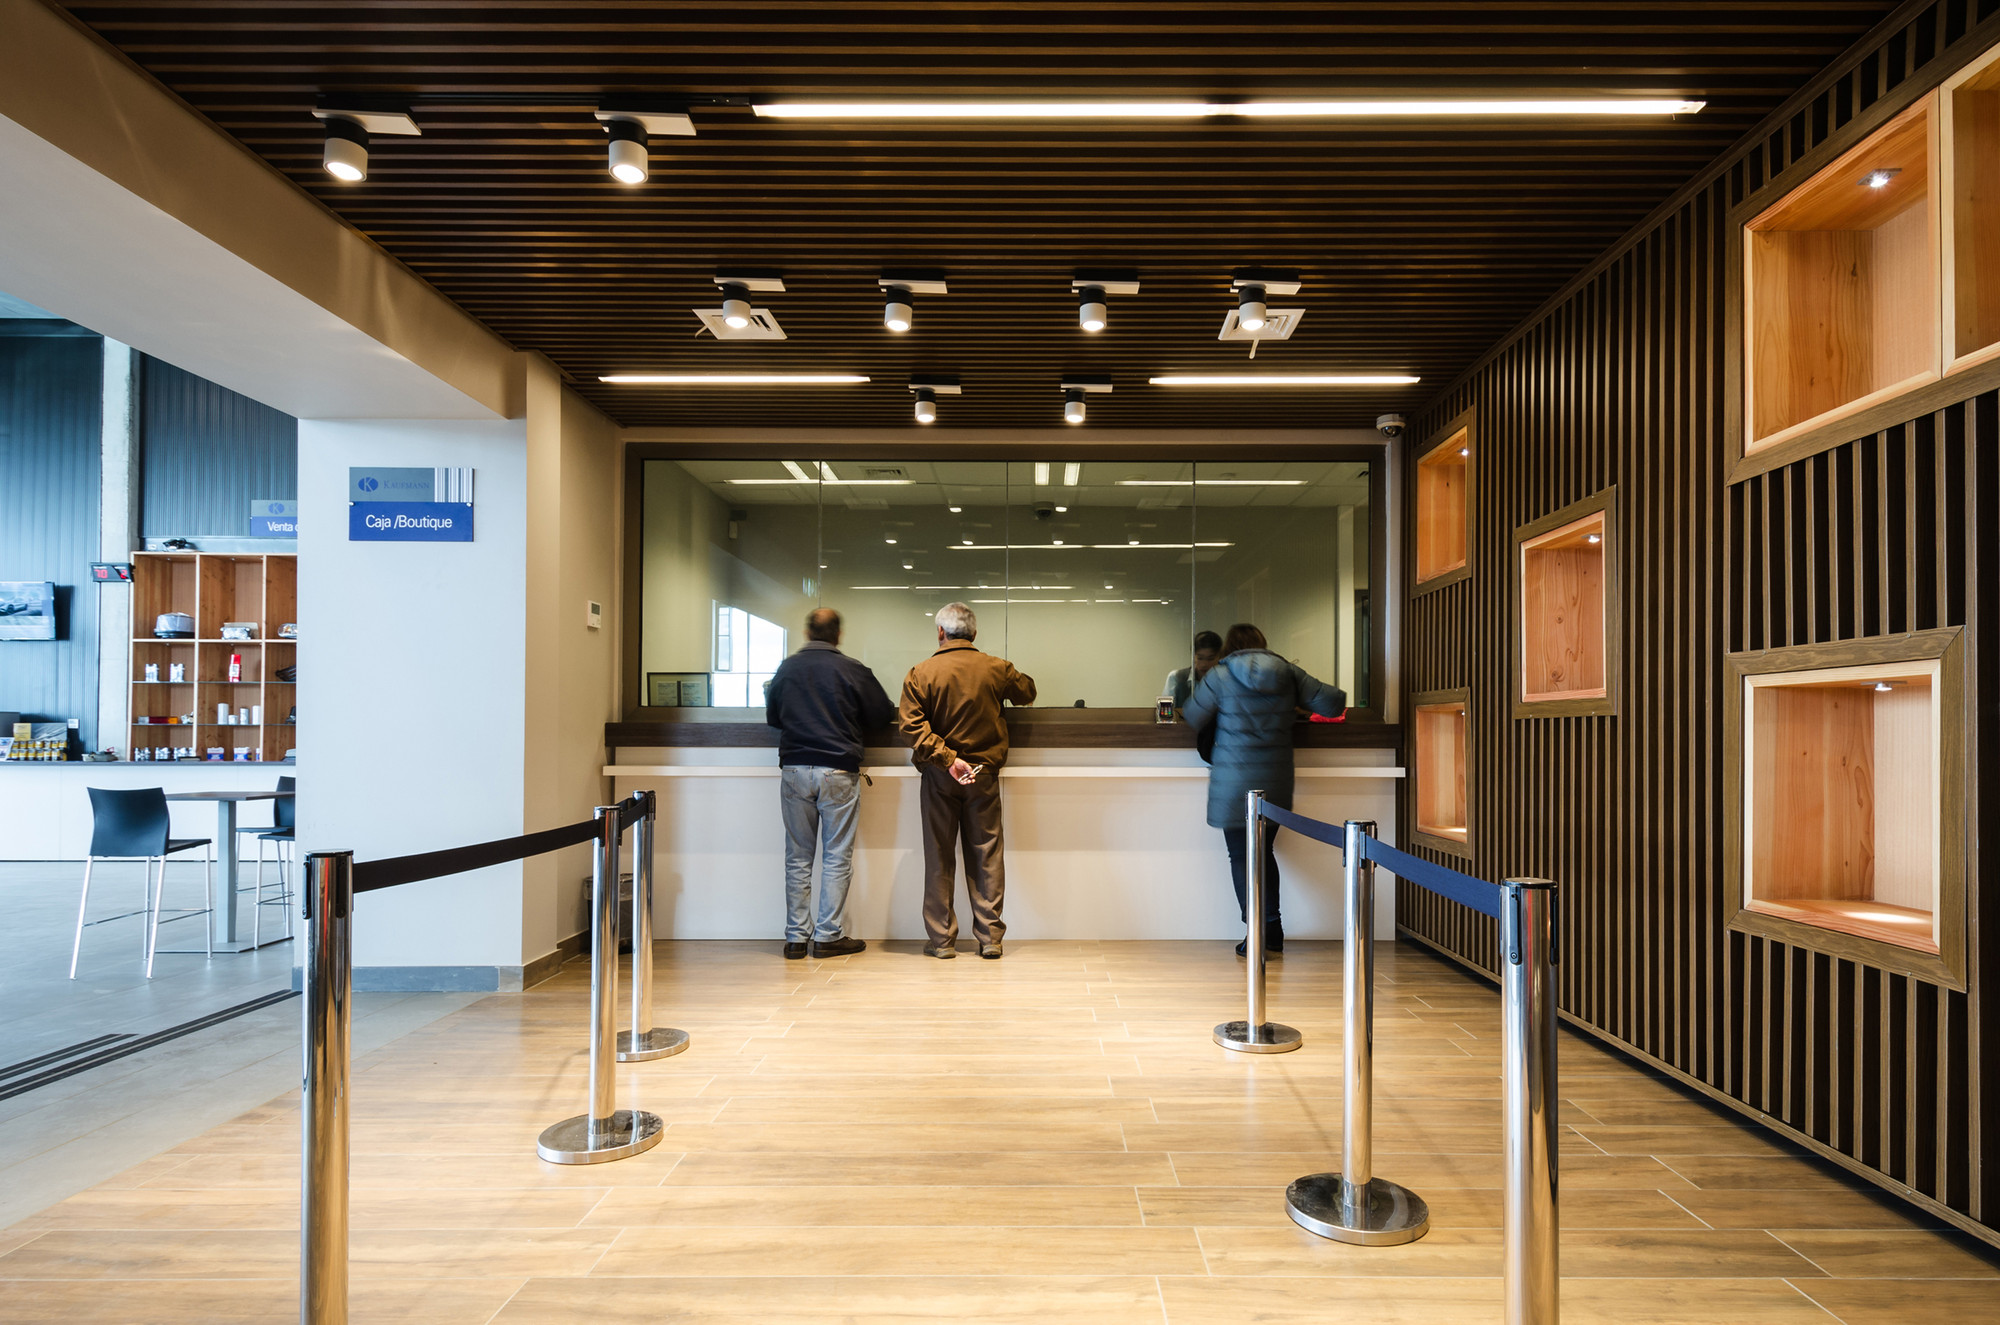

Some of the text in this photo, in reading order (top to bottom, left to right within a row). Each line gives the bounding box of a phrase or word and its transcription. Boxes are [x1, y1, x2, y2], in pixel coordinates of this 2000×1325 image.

[267, 521, 294, 532] Venta
[365, 514, 453, 531] Caja /Boutique
